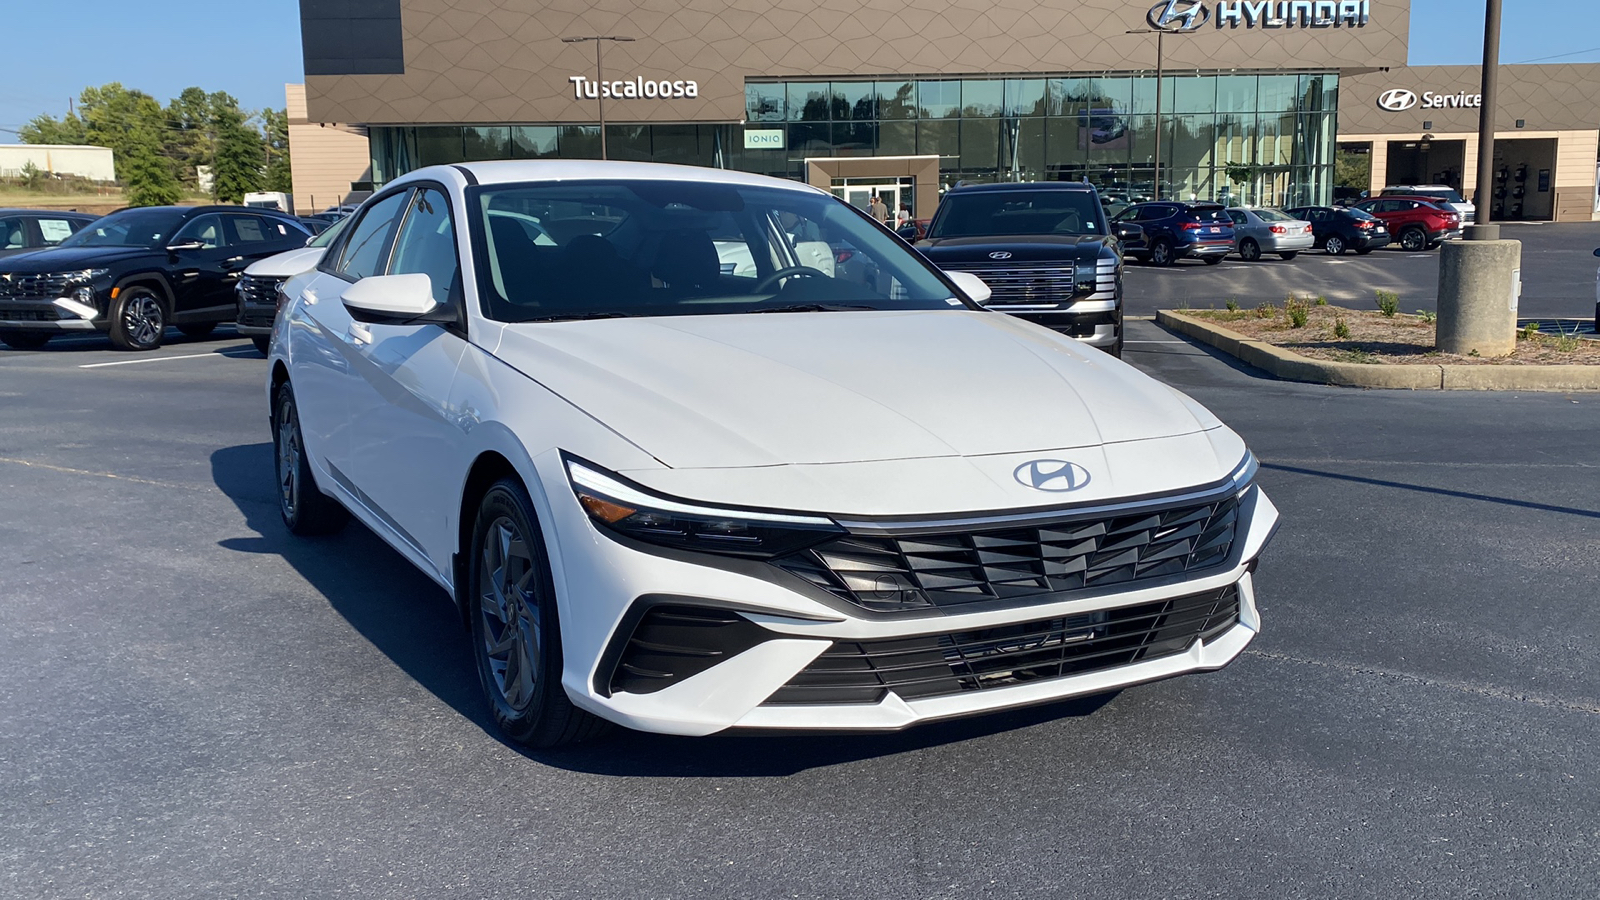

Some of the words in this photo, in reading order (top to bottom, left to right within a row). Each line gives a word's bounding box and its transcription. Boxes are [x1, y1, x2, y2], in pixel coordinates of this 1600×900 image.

[1218, 0, 1370, 27] HYUNDAI
[569, 75, 698, 98] Tuscaloosa
[1421, 90, 1482, 107] Service
[748, 135, 780, 143] IONIQ
